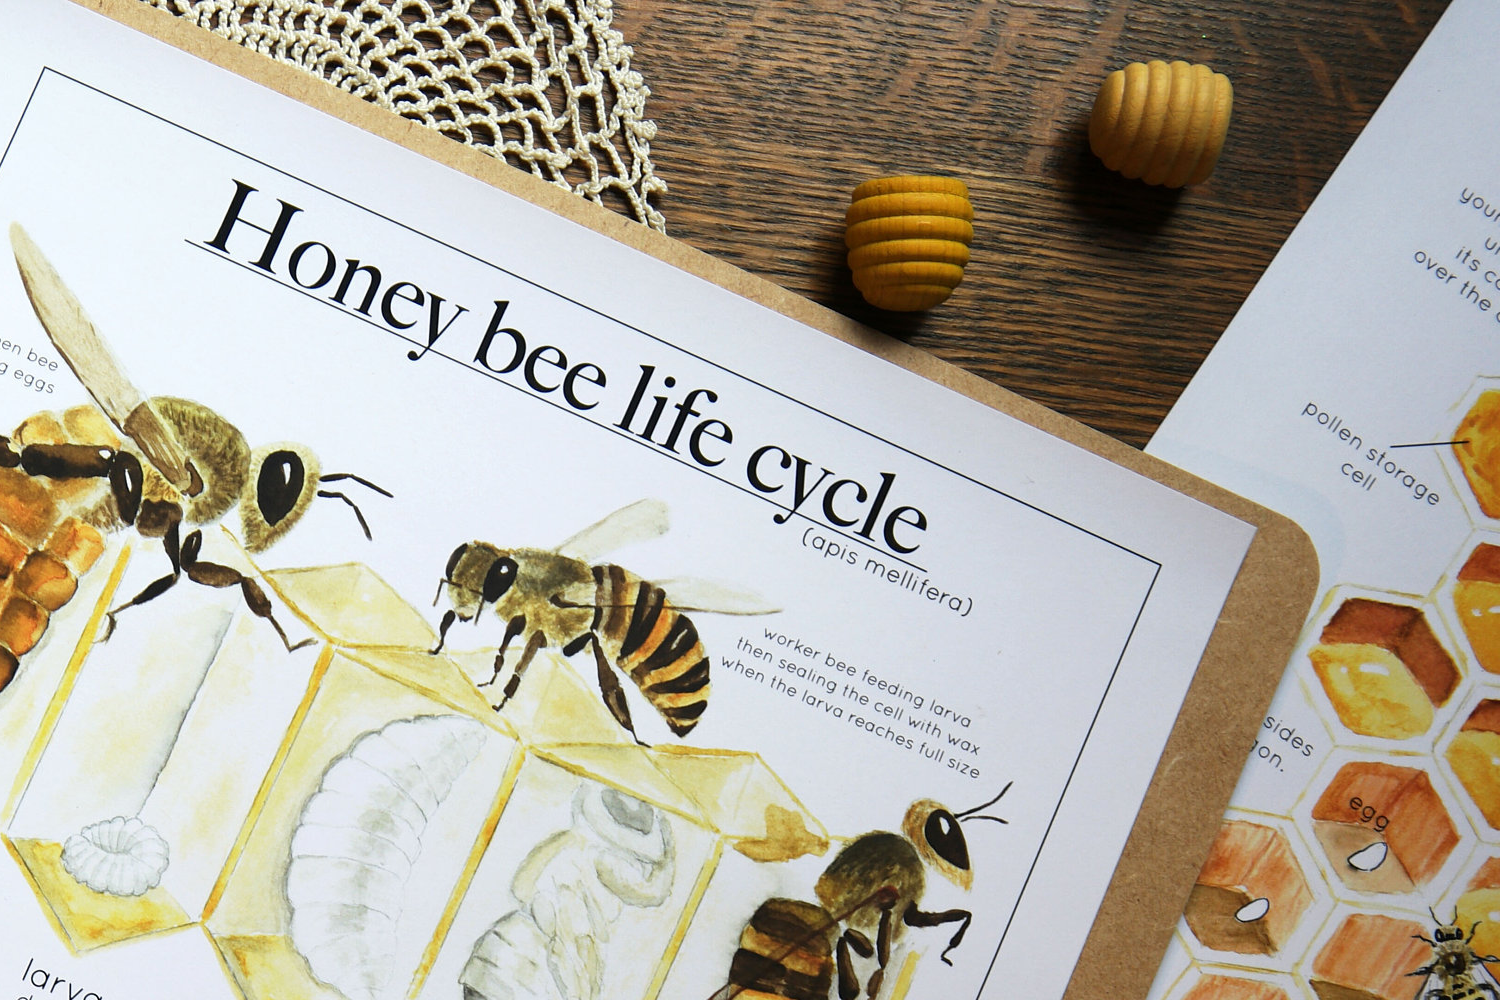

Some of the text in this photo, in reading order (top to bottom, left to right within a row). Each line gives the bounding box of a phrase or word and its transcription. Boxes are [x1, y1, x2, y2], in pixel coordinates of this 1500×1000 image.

[1414, 251, 1457, 284] over
[1460, 281, 1491, 311] the
[1456, 246, 1481, 271] its
[14, 370, 54, 393] eggs
[27, 349, 58, 371] bee
[203, 179, 928, 554] Honey bee life cycle
[1302, 403, 1439, 505] pollen storage
[1342, 463, 1376, 490] cell
[803, 528, 972, 617] (apis mellifera)
[737, 637, 980, 755] then sealing the cell with wax
[765, 629, 971, 727] worker bee feeding larva
[722, 657, 979, 778] when the larva reaches full size
[1263, 716, 1314, 757] sides
[1350, 797, 1389, 832] egg
